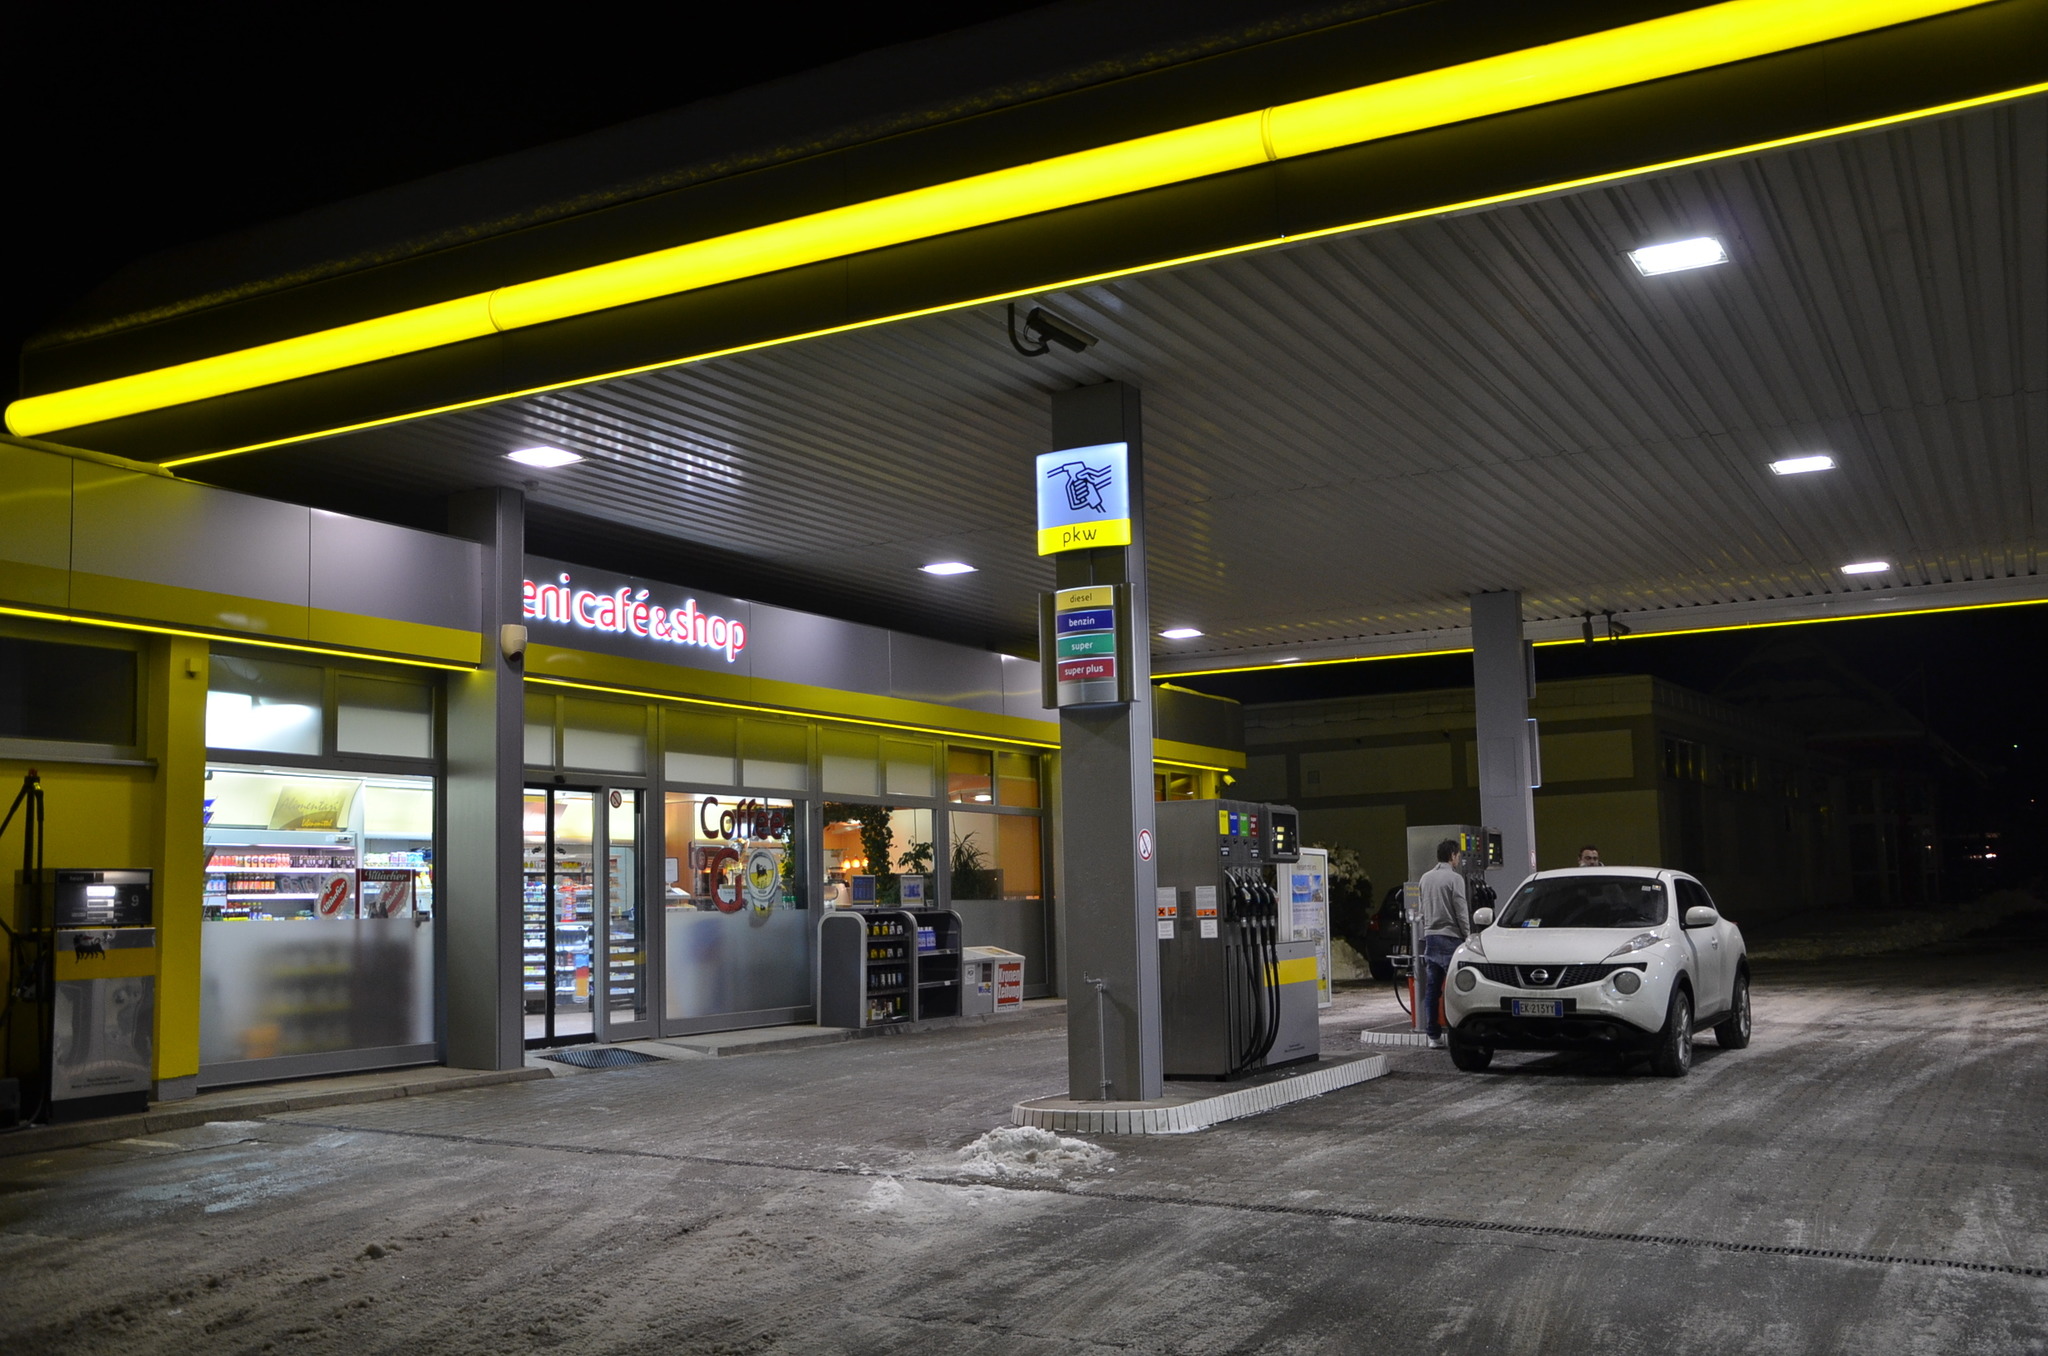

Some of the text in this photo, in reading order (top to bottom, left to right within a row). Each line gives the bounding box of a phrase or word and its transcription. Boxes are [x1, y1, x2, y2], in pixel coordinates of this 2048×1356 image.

[1062, 526, 1097, 547] pkw
[1069, 592, 1093, 604] diesel
[1068, 615, 1095, 627] benzin
[1071, 640, 1094, 652] super
[1064, 663, 1104, 677] super plus
[700, 796, 785, 840] Coffee
[998, 968, 1021, 983] Kronen
